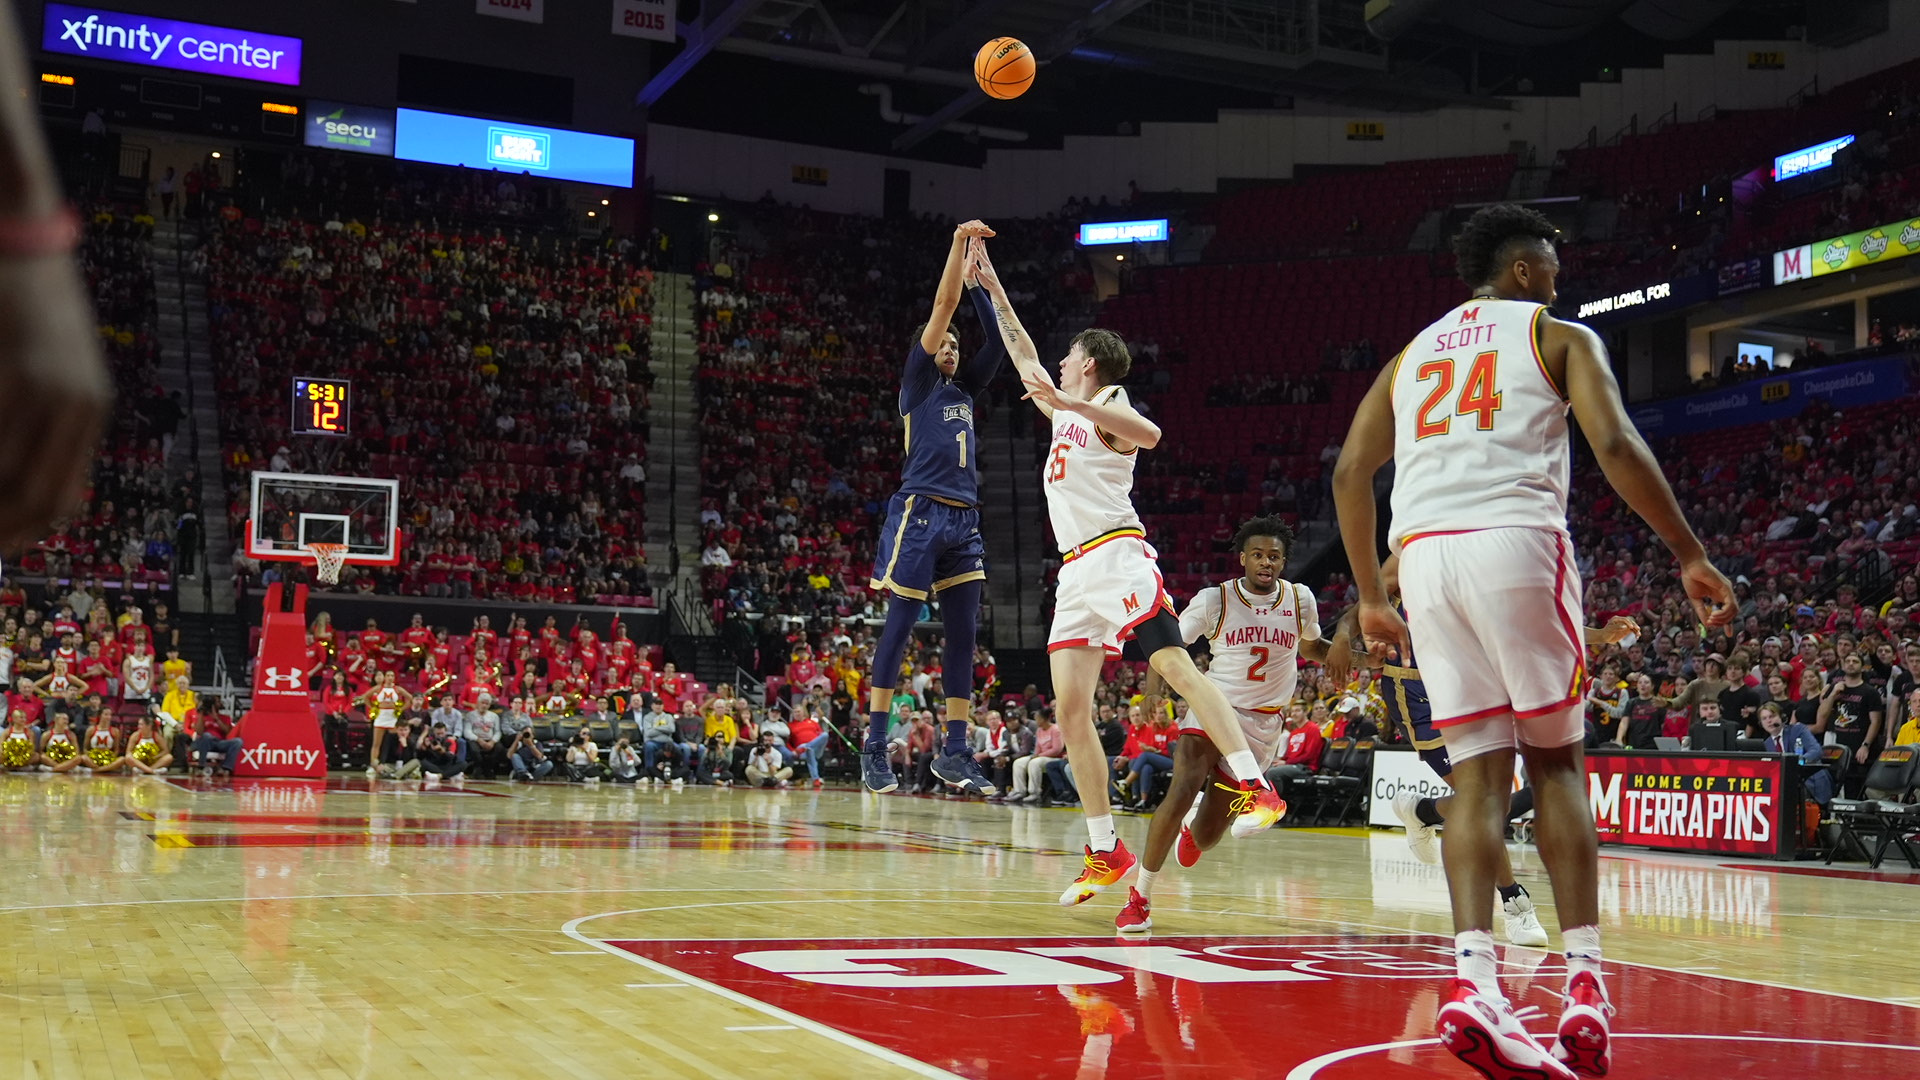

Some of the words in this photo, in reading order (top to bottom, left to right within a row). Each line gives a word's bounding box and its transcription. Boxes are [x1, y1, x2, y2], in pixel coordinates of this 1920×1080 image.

[624, 9, 665, 30] 2015
[60, 15, 173, 60] xfinity
[177, 39, 284, 70] center
[325, 121, 377, 139] secu
[1823, 244, 1851, 264] Starry
[1860, 234, 1889, 255] Starry
[1783, 248, 1802, 278] M
[1577, 297, 1613, 319] JAHARI
[1613, 289, 1646, 310] LONG,
[1646, 282, 1671, 301] FOR
[1458, 306, 1482, 325] M
[1434, 323, 1497, 353] SCOTT
[307, 383, 345, 401] 5:31
[1415, 349, 1503, 442] 24
[1765, 386, 1785, 399] 116
[313, 401, 340, 430] 12
[945, 407, 959, 419] THE
[956, 430, 967, 469] 1
[1047, 443, 1072, 484] 35
[1121, 591, 1141, 616] M
[1225, 626, 1296, 650] MARYLAND
[136, 671, 148, 681] 34
[1247, 646, 1269, 682] 2
[240, 742, 321, 771] xfinity
[1633, 774, 1682, 790] HOME
[1692, 776, 1716, 791] OF
[1727, 778, 1764, 794] THE
[1588, 772, 1624, 826] M
[1625, 790, 1772, 843] TERRAPINS
